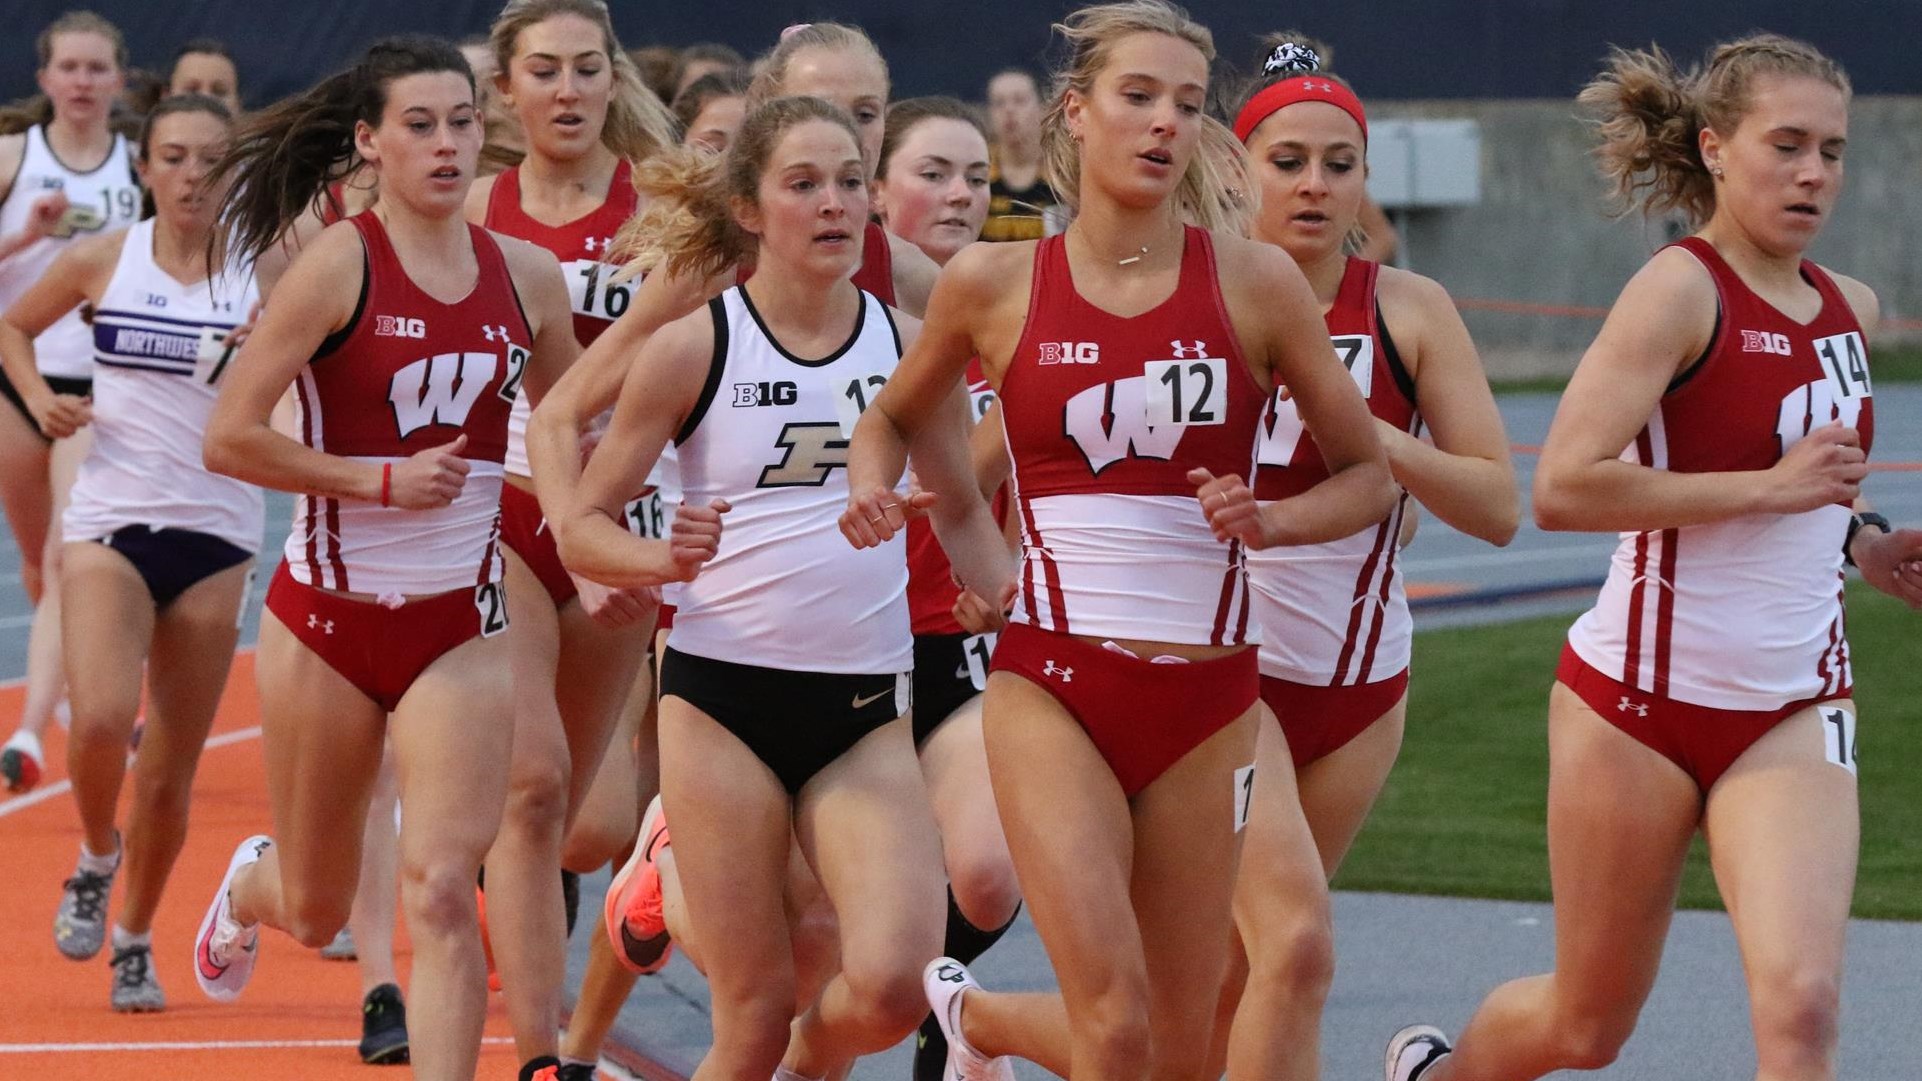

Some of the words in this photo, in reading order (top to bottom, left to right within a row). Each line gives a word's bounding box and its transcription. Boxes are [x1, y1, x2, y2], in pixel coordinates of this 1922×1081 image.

[101, 187, 134, 219] 19
[580, 264, 632, 318] 16
[500, 348, 525, 400] 2
[1332, 339, 1362, 373] 7
[1821, 335, 1869, 397] 14
[388, 352, 498, 440] W
[1160, 362, 1215, 423] 12
[1062, 375, 1187, 478] W
[1242, 768, 1254, 823] 1
